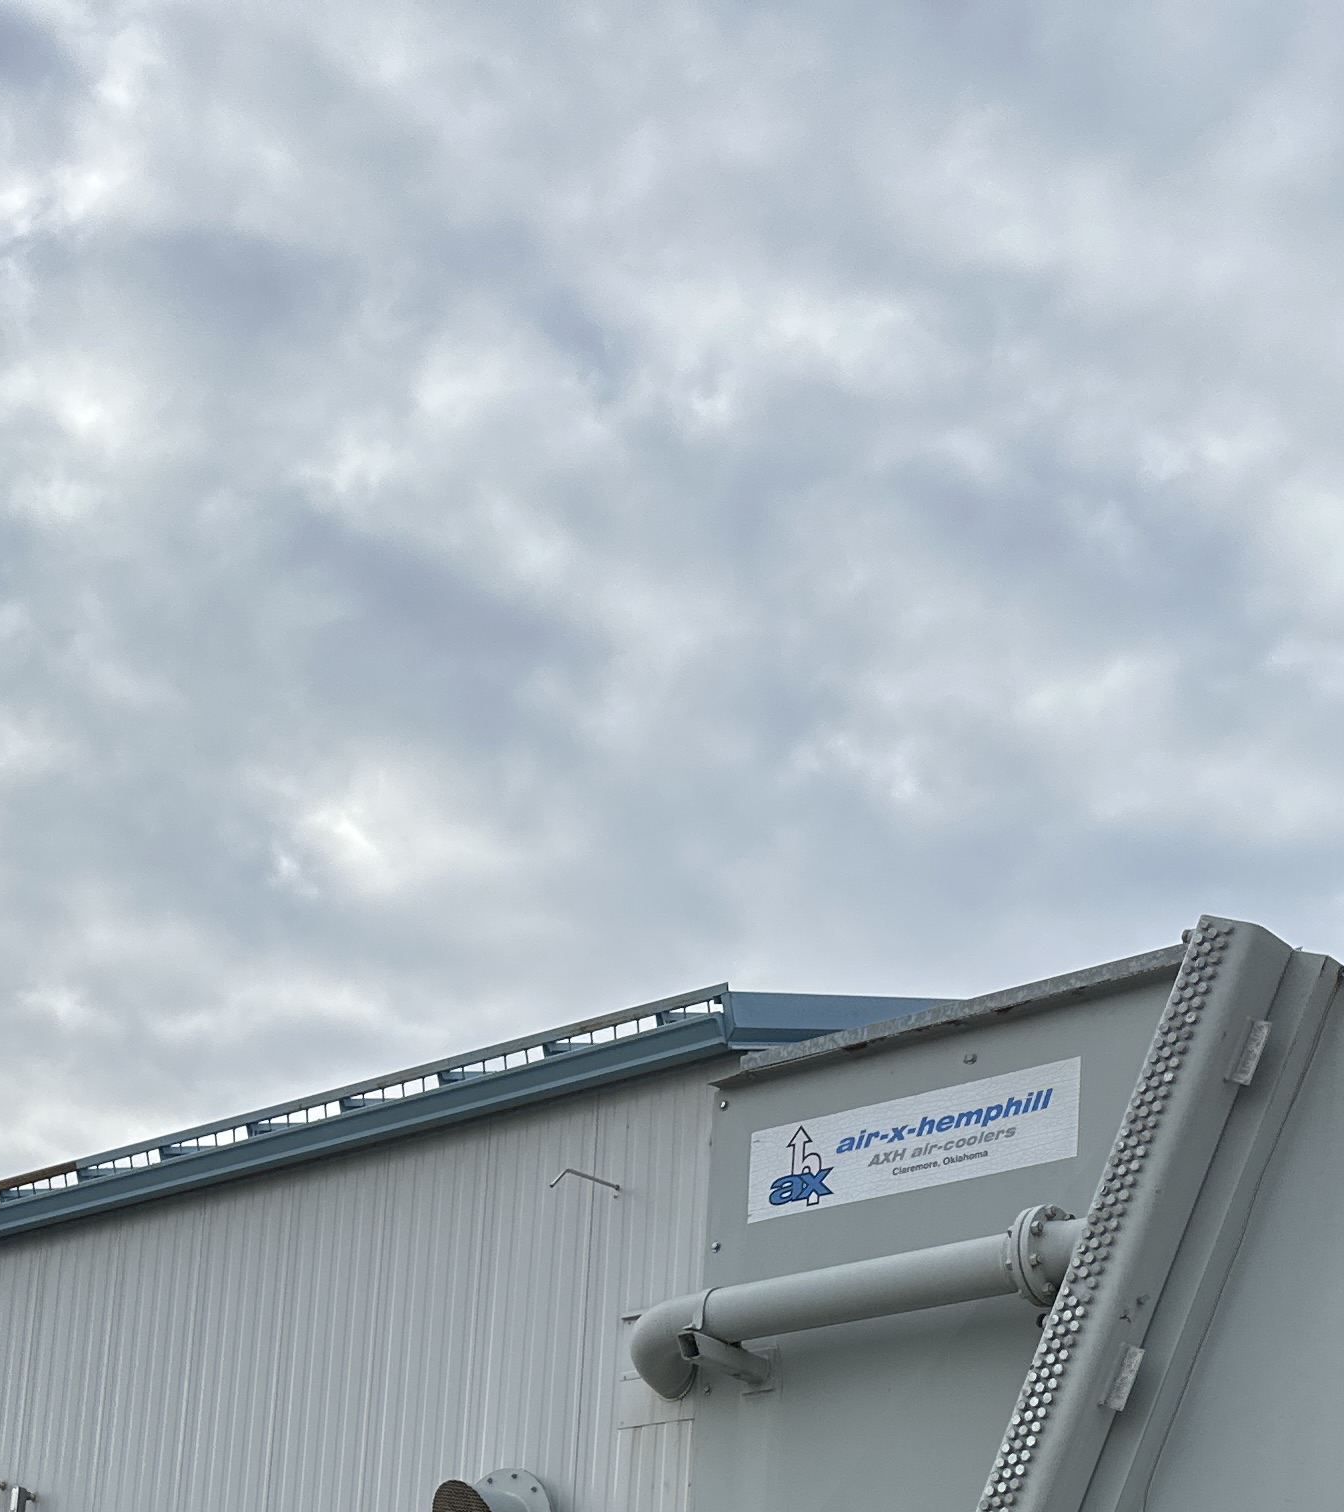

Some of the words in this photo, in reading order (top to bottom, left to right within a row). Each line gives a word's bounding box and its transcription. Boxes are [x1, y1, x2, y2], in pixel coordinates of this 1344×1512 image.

[836, 1087, 1053, 1154] air-x-hemphill
[867, 1148, 907, 1167] AXH
[910, 1126, 1017, 1159] air-coolers
[892, 1161, 941, 1176] Claremore,
[943, 1149, 988, 1166] Oklahoma
